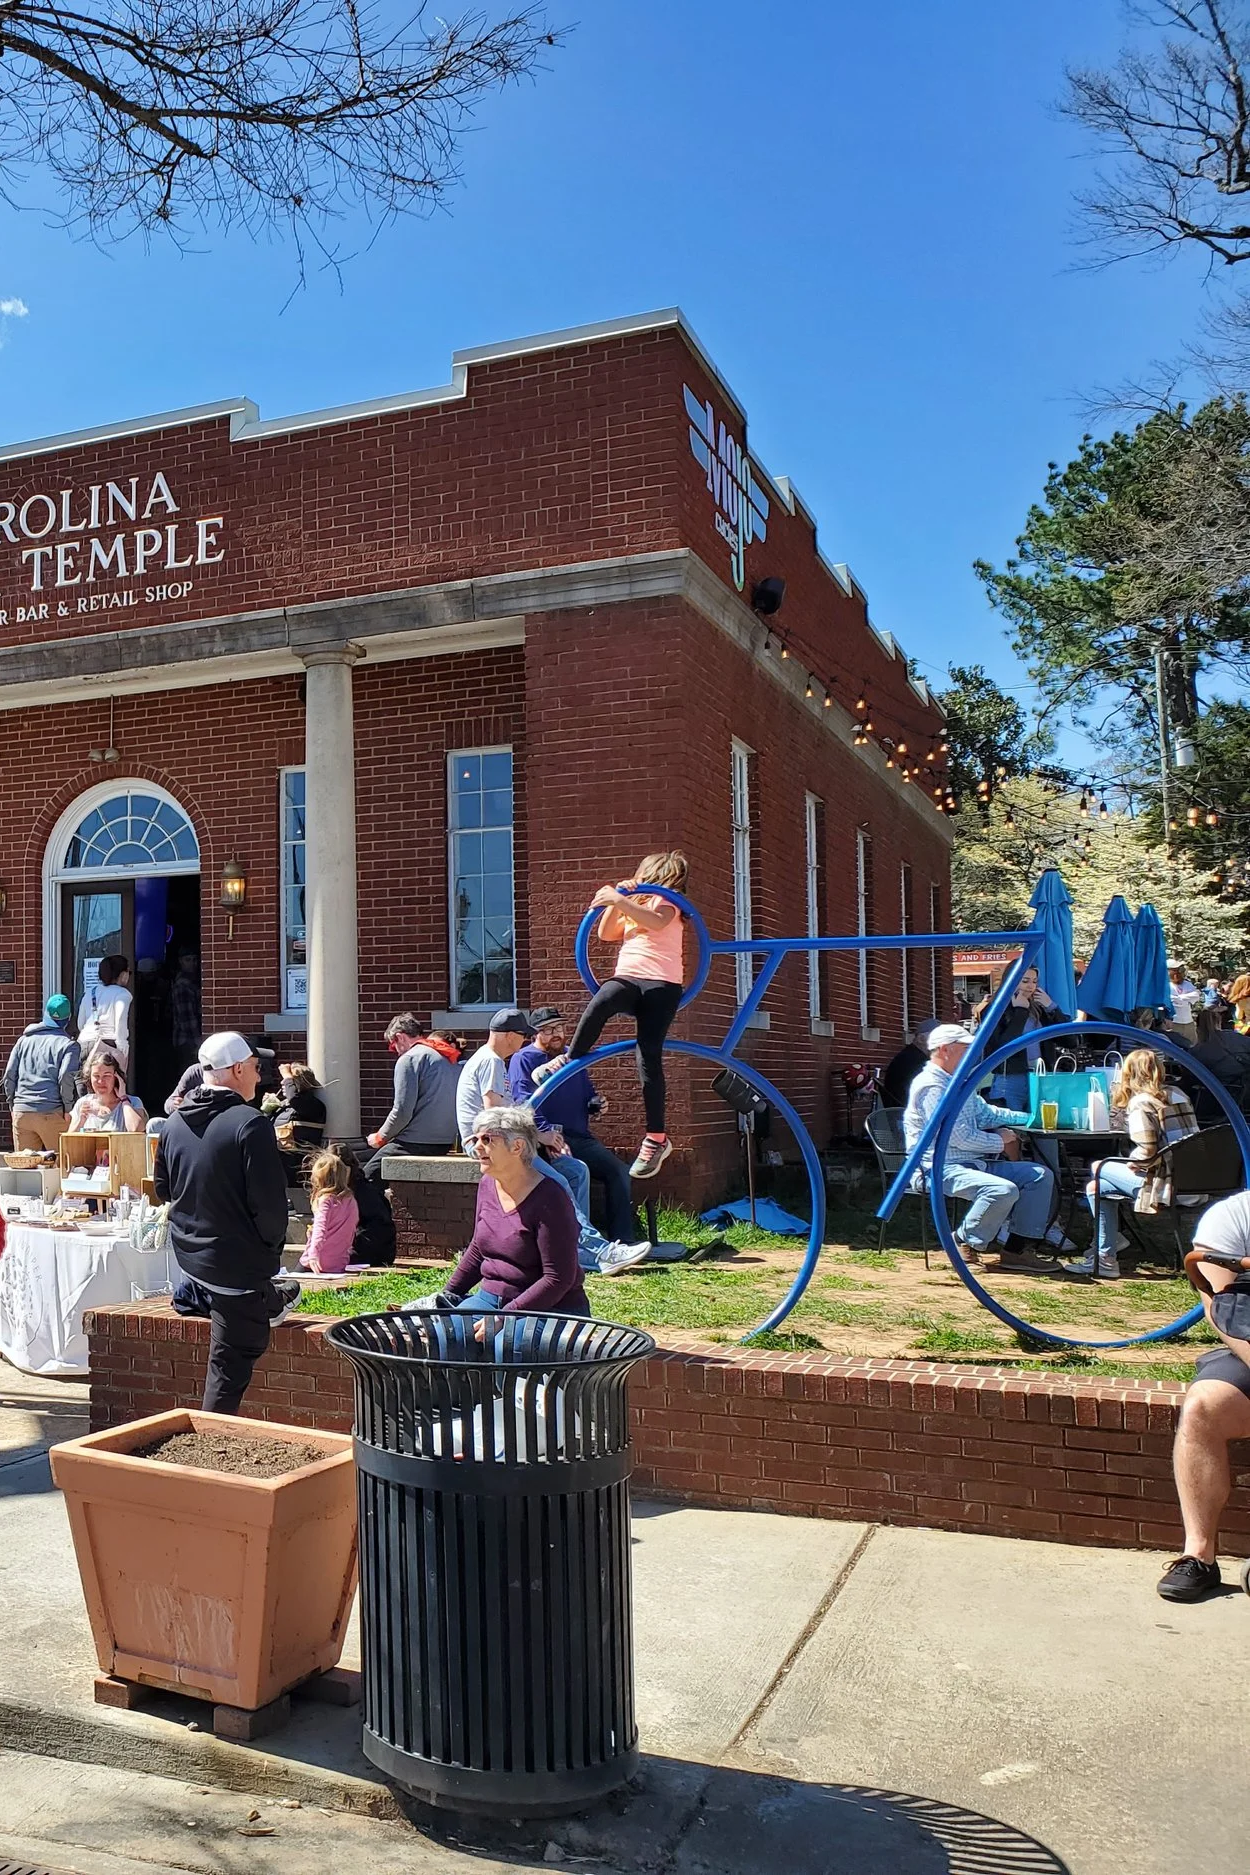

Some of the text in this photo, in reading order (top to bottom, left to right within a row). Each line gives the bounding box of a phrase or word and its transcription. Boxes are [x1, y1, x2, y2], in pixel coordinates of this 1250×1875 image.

[21, 516, 225, 592] TEMPLE
[15, 603, 50, 623] BAR
[57, 603, 69, 616] &
[76, 590, 139, 614] RETAIL
[145, 581, 193, 603] SHOP
[981, 953, 1007, 961] FRIES
